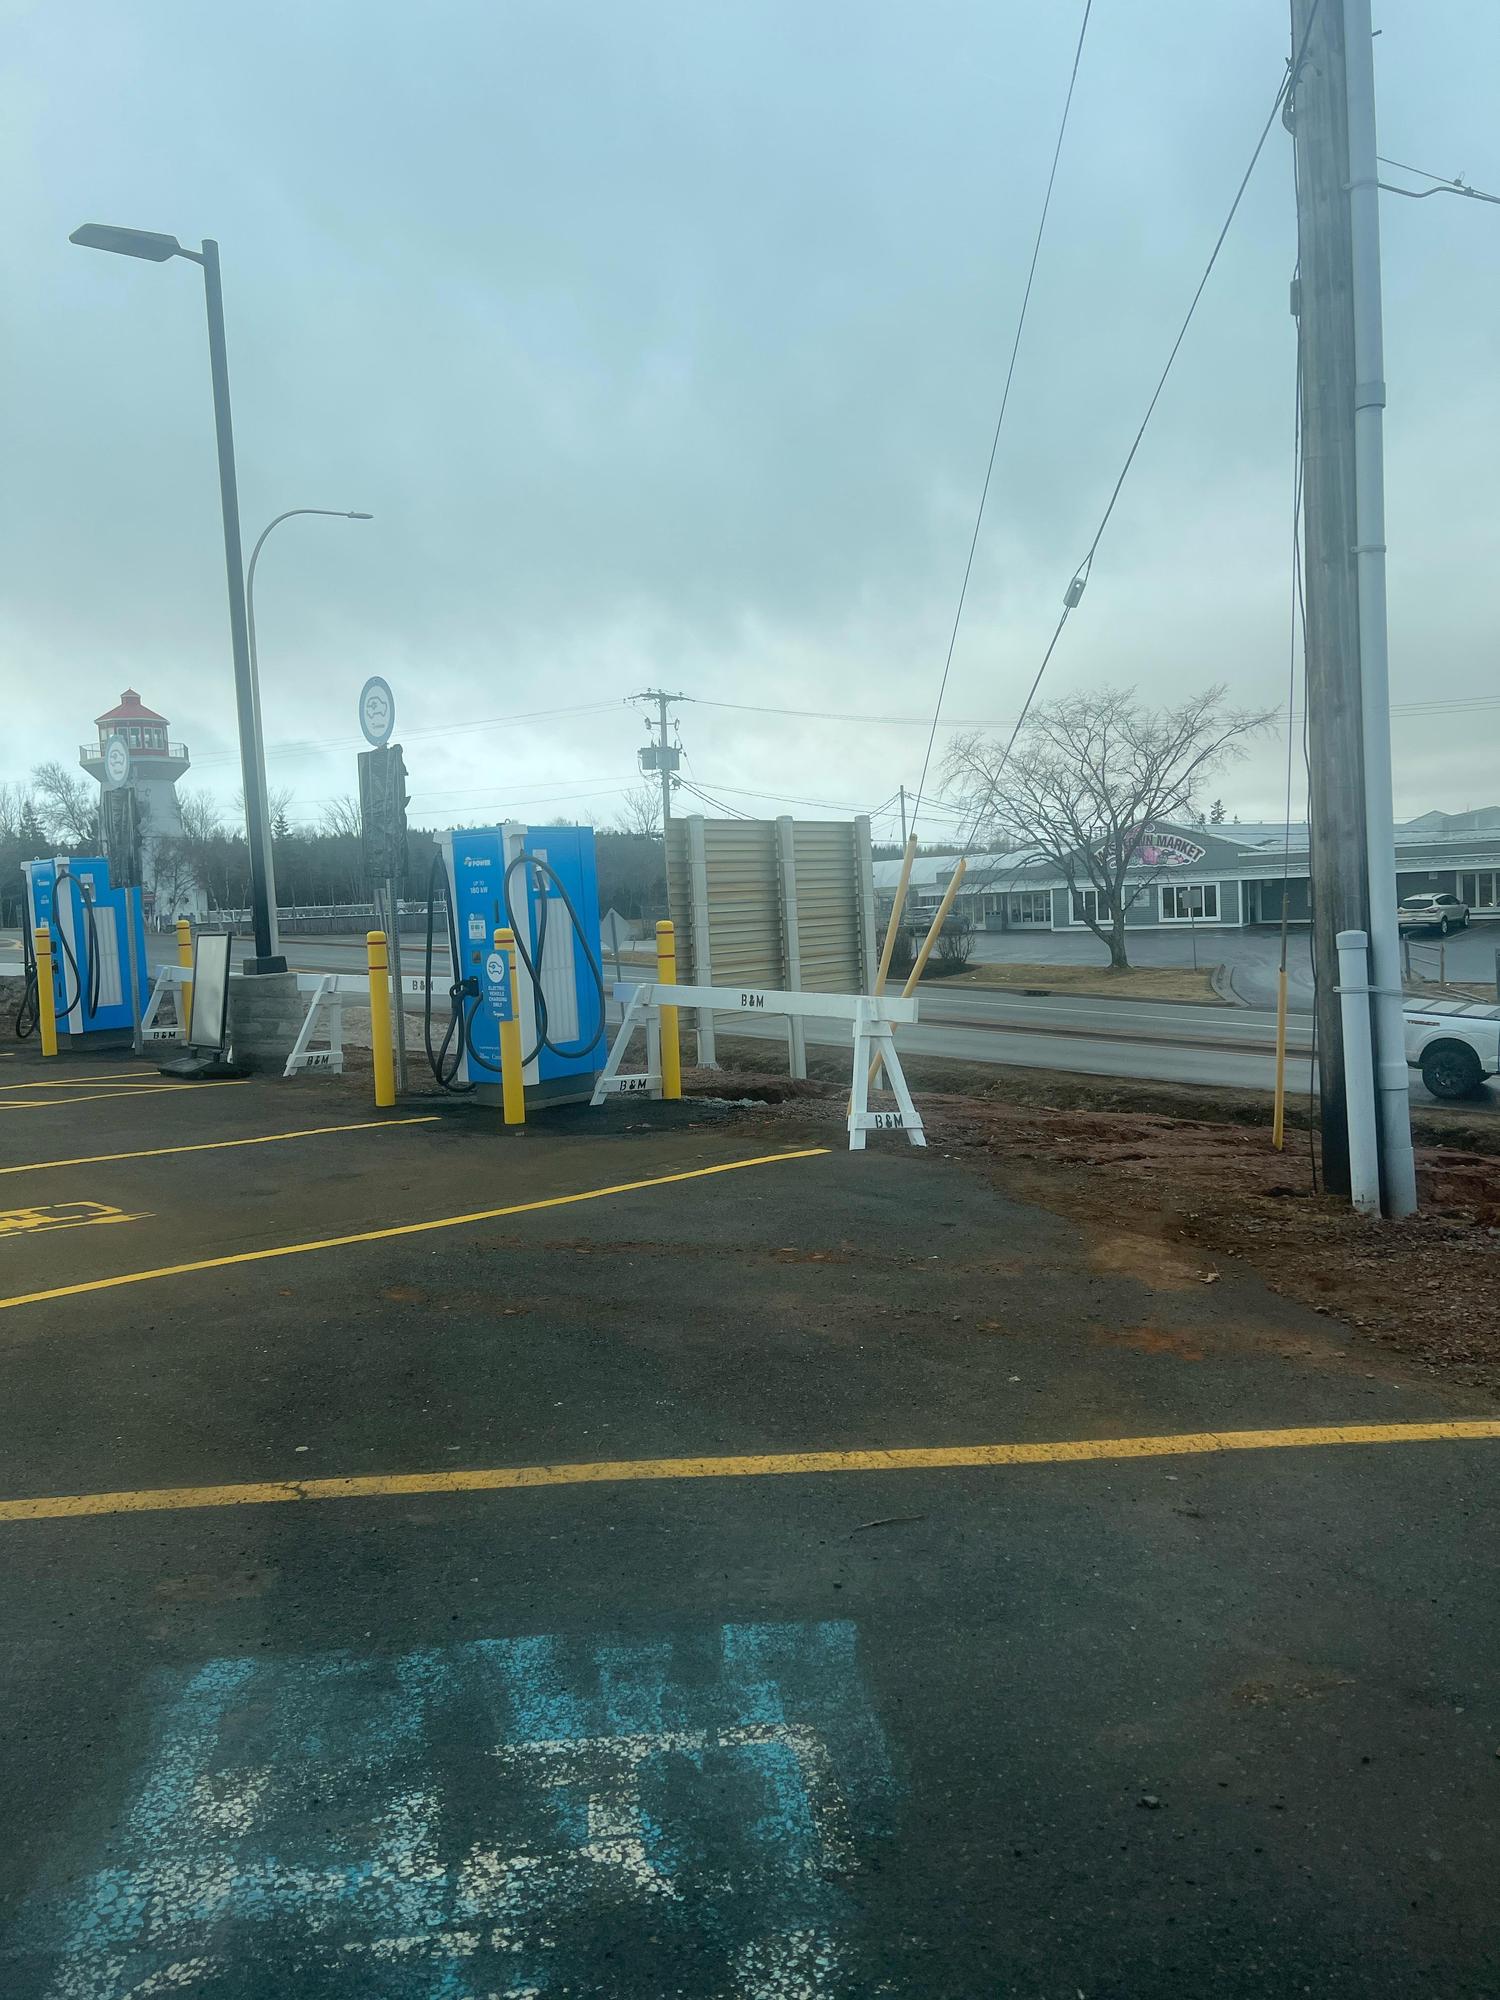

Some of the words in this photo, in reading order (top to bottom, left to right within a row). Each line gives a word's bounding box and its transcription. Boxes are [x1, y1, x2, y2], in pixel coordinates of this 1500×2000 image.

[1155, 834, 1204, 861] MARKET
[412, 980, 434, 991] B&
[741, 993, 764, 1008] B&M
[153, 1031, 177, 1040] B&M
[306, 1056, 330, 1066] B&M
[619, 1078, 648, 1091] B&M
[875, 1113, 904, 1128] B&M
